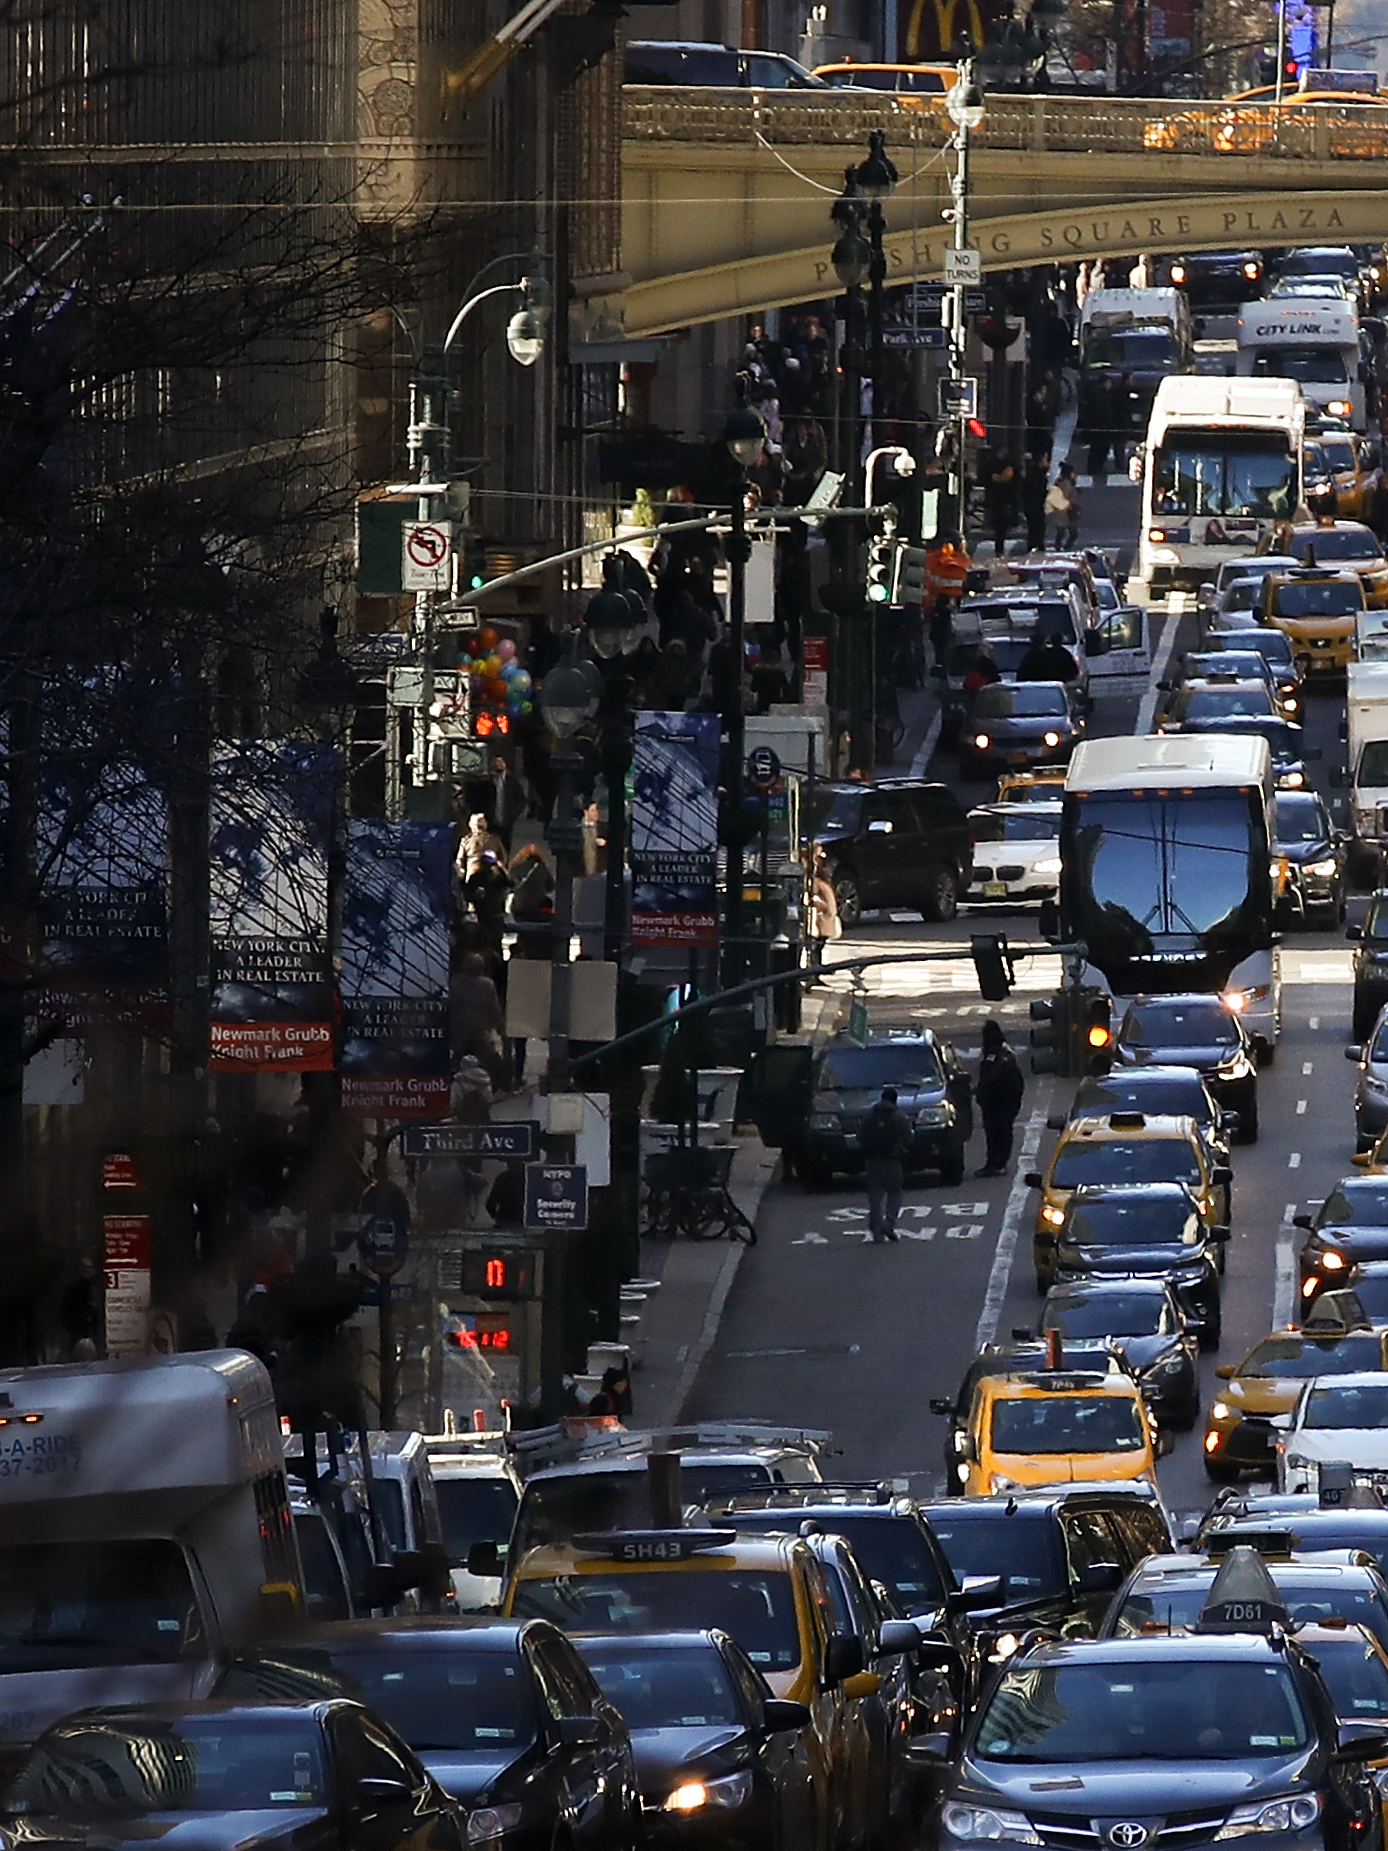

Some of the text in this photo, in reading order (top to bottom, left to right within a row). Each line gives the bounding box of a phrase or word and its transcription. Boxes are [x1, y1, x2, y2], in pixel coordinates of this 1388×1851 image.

[816, 208, 1344, 280] PSHNG SQUARE PLAZA
[955, 254, 971, 266] NO
[946, 269, 980, 280] TURNS
[1256, 325, 1288, 336] CITY
[637, 873, 649, 883] IN
[676, 875, 713, 885] ESTATE
[632, 914, 715, 926] Newmark Grubb
[248, 940, 286, 952] YORK
[236, 955, 303, 968] A LEADER
[217, 969, 325, 982] IN REAL ESTATE
[343, 1000, 370, 1010] NEW
[362, 1014, 372, 1024] A
[211, 1026, 330, 1041] Newmark Grubb
[347, 1026, 360, 1037] IN
[211, 1044, 304, 1060] Knight Frank
[341, 1077, 449, 1092] Newmark Grubb
[388, 1094, 426, 1107] Frank
[423, 1132, 515, 1150] Third Ave
[537, 1198, 577, 1213] Security
[537, 1209, 576, 1219] Camera
[107, 1272, 116, 1288] 3
[0, 1435, 81, 1456] -A-RIDE
[623, 1543, 682, 1558] 5H43
[1224, 1604, 1262, 1620] 7D61
